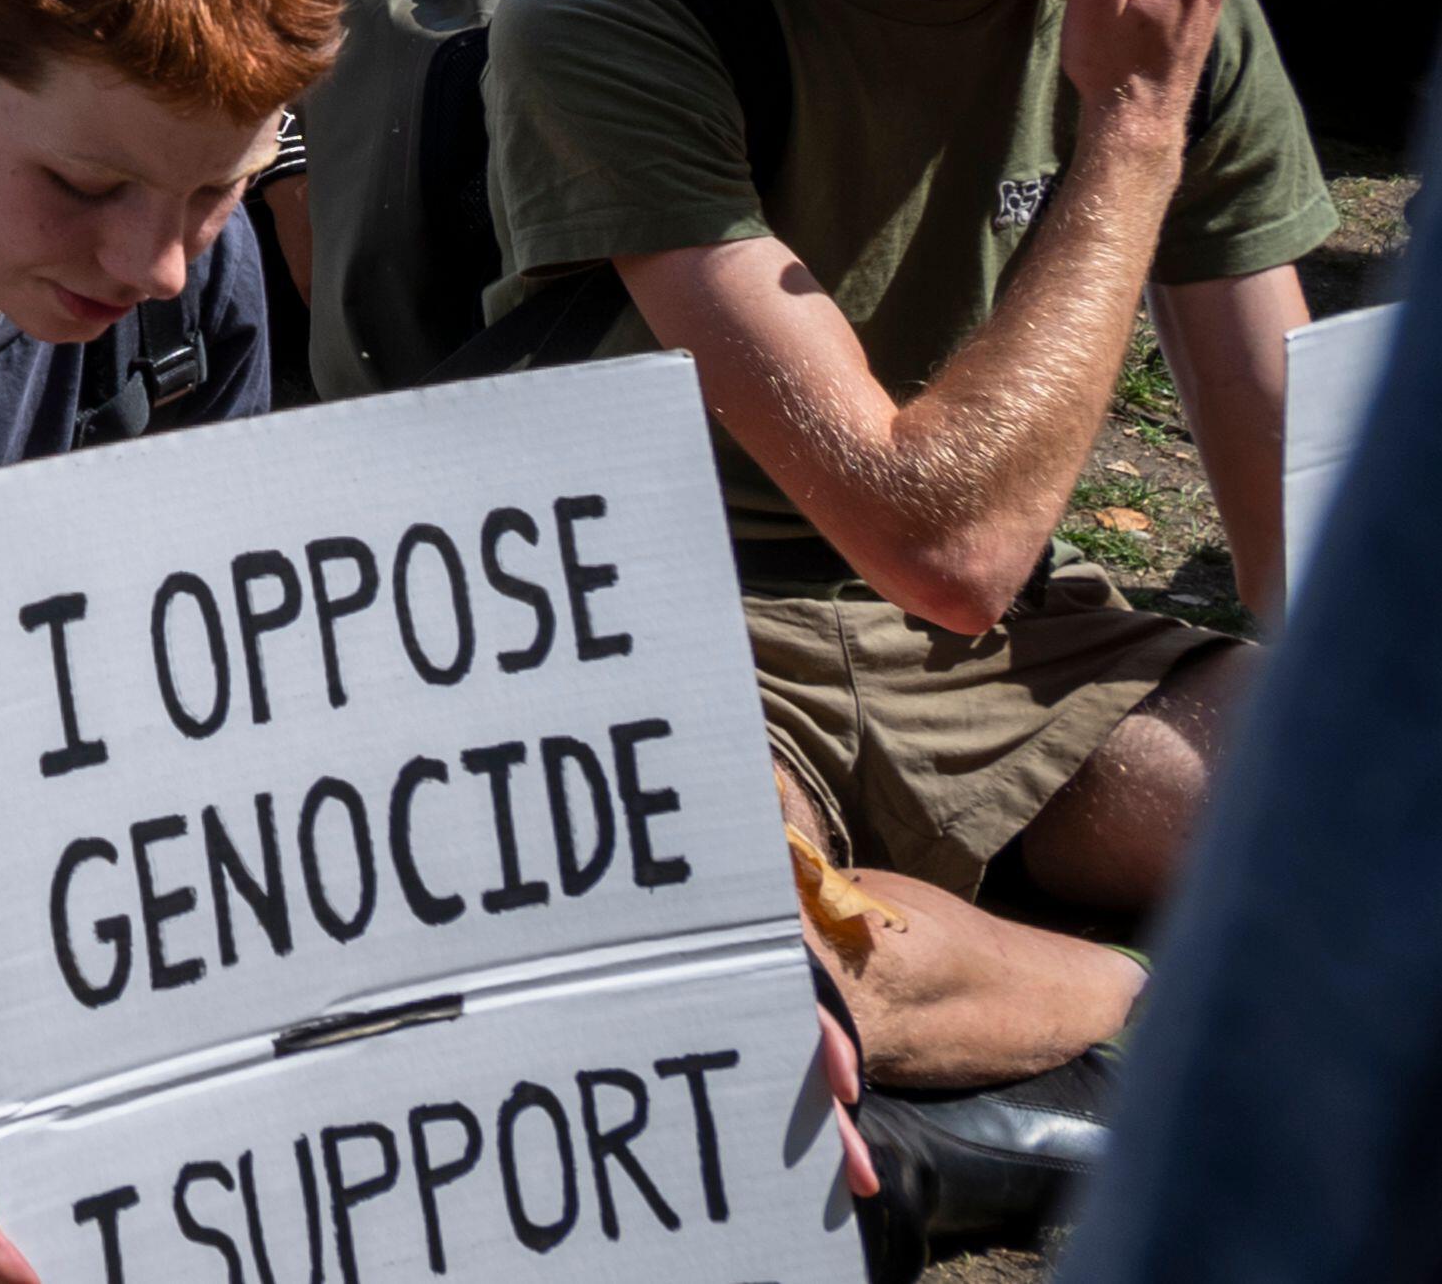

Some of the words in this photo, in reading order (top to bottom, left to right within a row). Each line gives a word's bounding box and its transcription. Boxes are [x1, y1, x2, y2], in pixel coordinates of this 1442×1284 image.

[18, 589, 110, 778] I
[149, 492, 635, 742] OPPOSE
[48, 715, 692, 1010] GENOCIDE
[70, 1184, 142, 1284] I
[170, 1047, 742, 1284] SUPPORT
